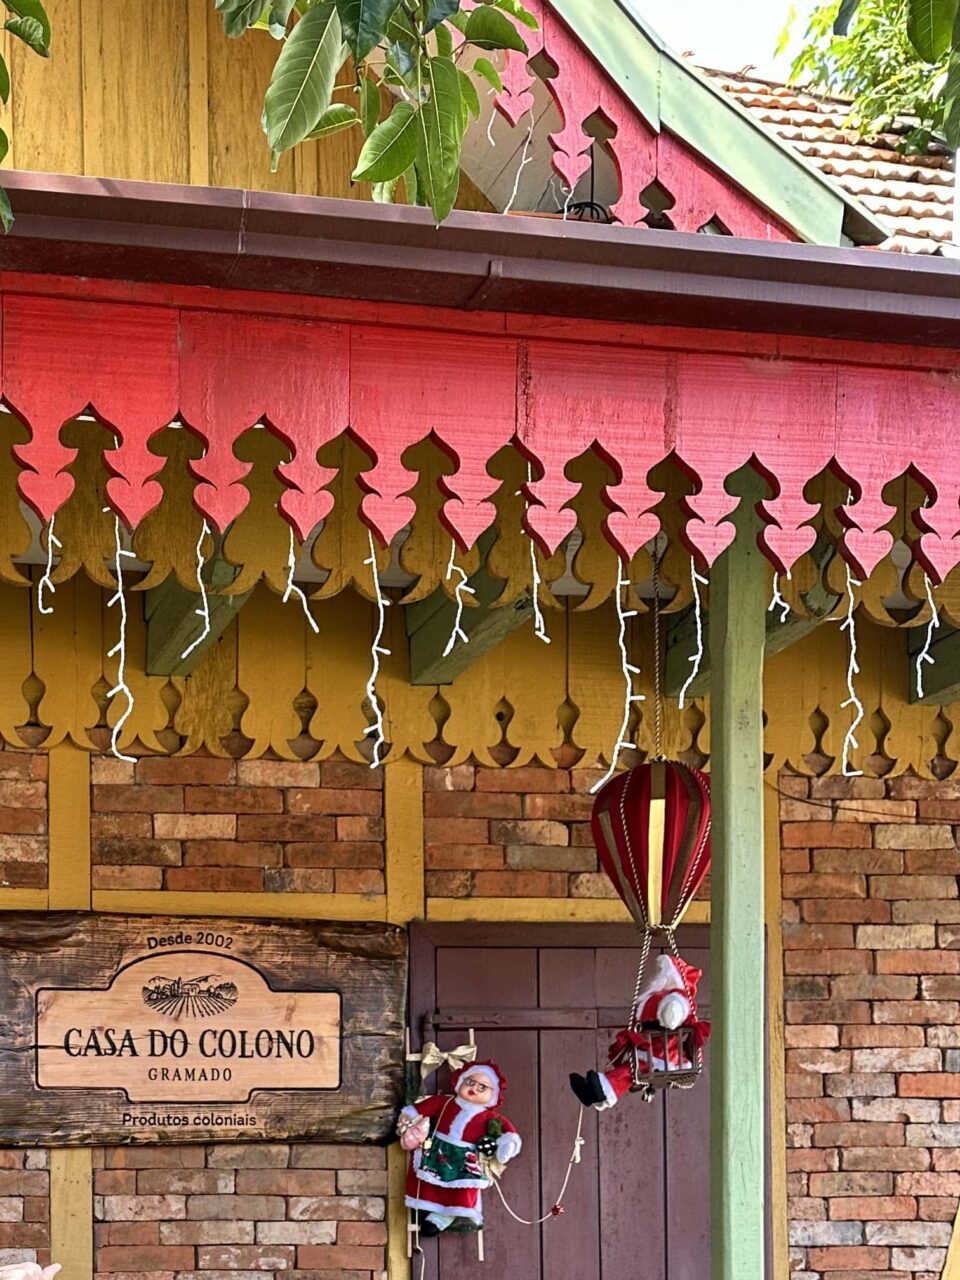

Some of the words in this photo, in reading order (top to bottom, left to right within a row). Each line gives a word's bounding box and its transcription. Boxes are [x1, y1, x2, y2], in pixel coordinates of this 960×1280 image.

[147, 932, 193, 950] Desde
[196, 931, 234, 950] 2002
[63, 1026, 139, 1058] CASA
[147, 1028, 190, 1059] DO
[198, 1028, 316, 1060] COLONO
[147, 1066, 233, 1083] GRAMADO
[122, 1112, 189, 1128] Produtos
[193, 1112, 257, 1127] coloniais
